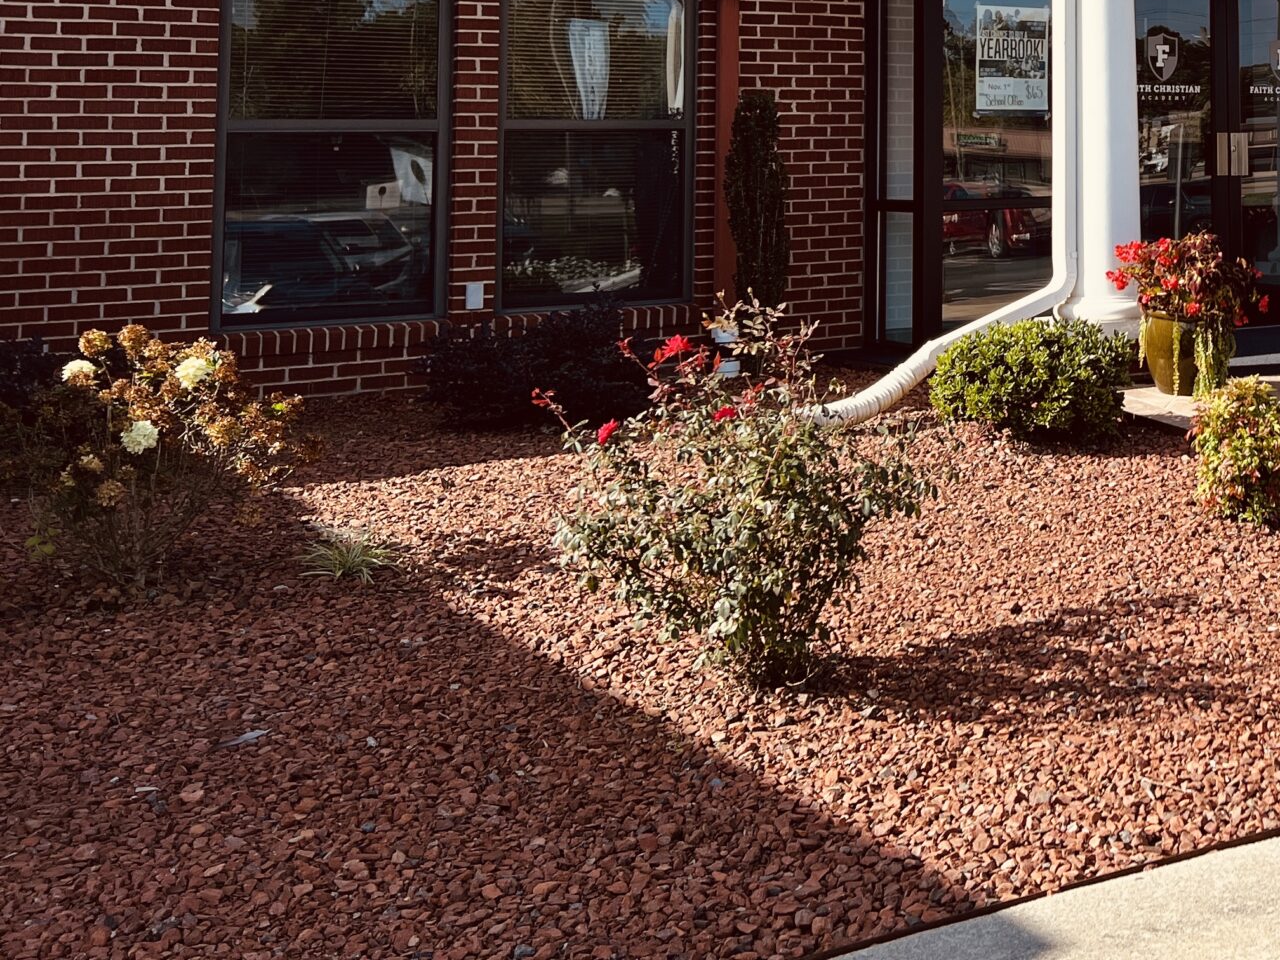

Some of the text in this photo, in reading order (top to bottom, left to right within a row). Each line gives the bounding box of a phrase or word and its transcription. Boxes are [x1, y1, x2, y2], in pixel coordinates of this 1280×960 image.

[979, 38, 1044, 60] YEARBOOK!
[1155, 44, 1169, 67] F
[1025, 84, 1043, 100] $65
[1136, 84, 1201, 93] ITH CHRISTIAN
[1249, 85, 1274, 94] FAITH
[985, 94, 1024, 107] School Office
